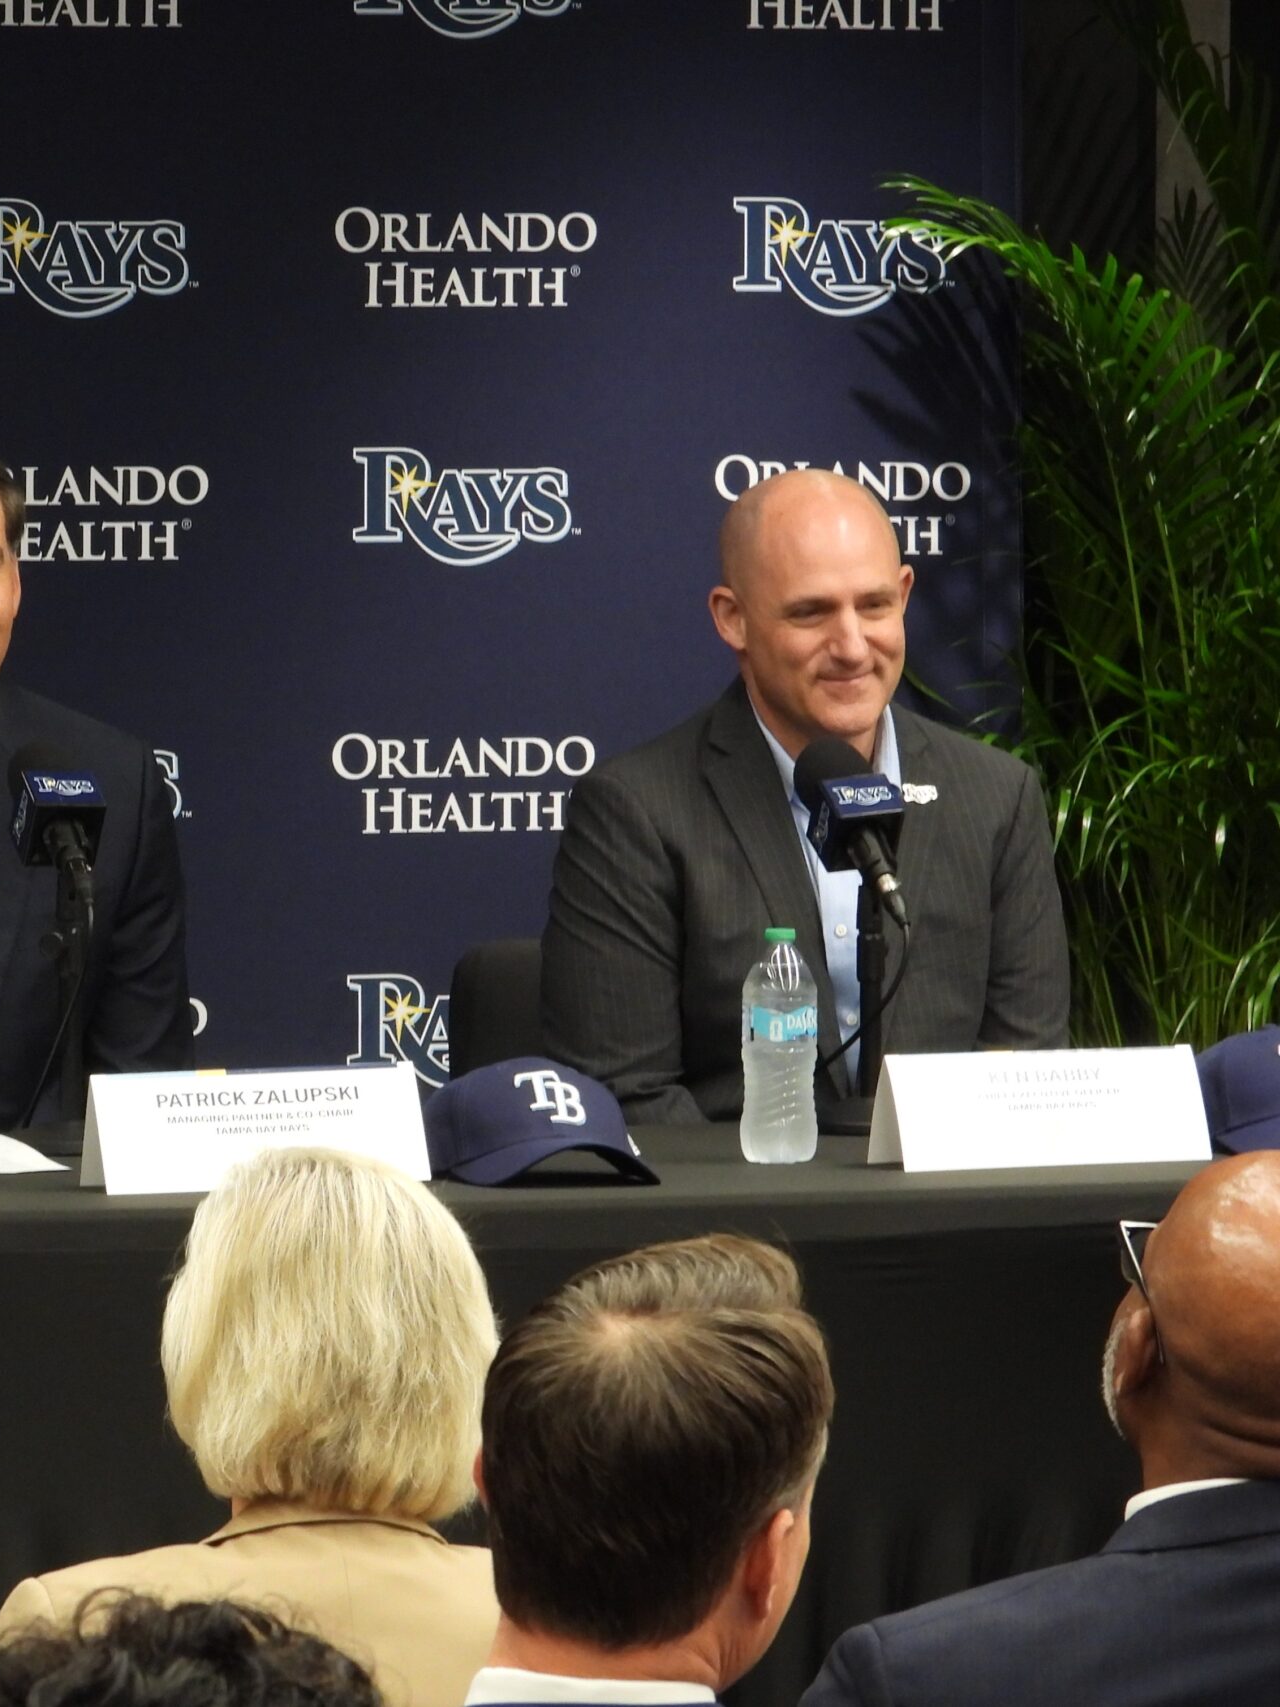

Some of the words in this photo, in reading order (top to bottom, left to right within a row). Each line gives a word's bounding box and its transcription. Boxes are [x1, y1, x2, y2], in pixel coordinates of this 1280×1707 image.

[335, 207, 597, 253] ORLANDO
[733, 197, 946, 317] RAYS
[13, 464, 209, 506] LANDO
[715, 454, 971, 501] ONDO
[353, 447, 572, 566] RAYS
[18, 521, 179, 561] EALTH
[332, 733, 595, 780] ORLANDO
[361, 787, 565, 834] HEALTH
[155, 1090, 247, 1109] PATRICK
[252, 1085, 360, 1105] ZALUPSKI
[514, 1070, 587, 1126] TB
